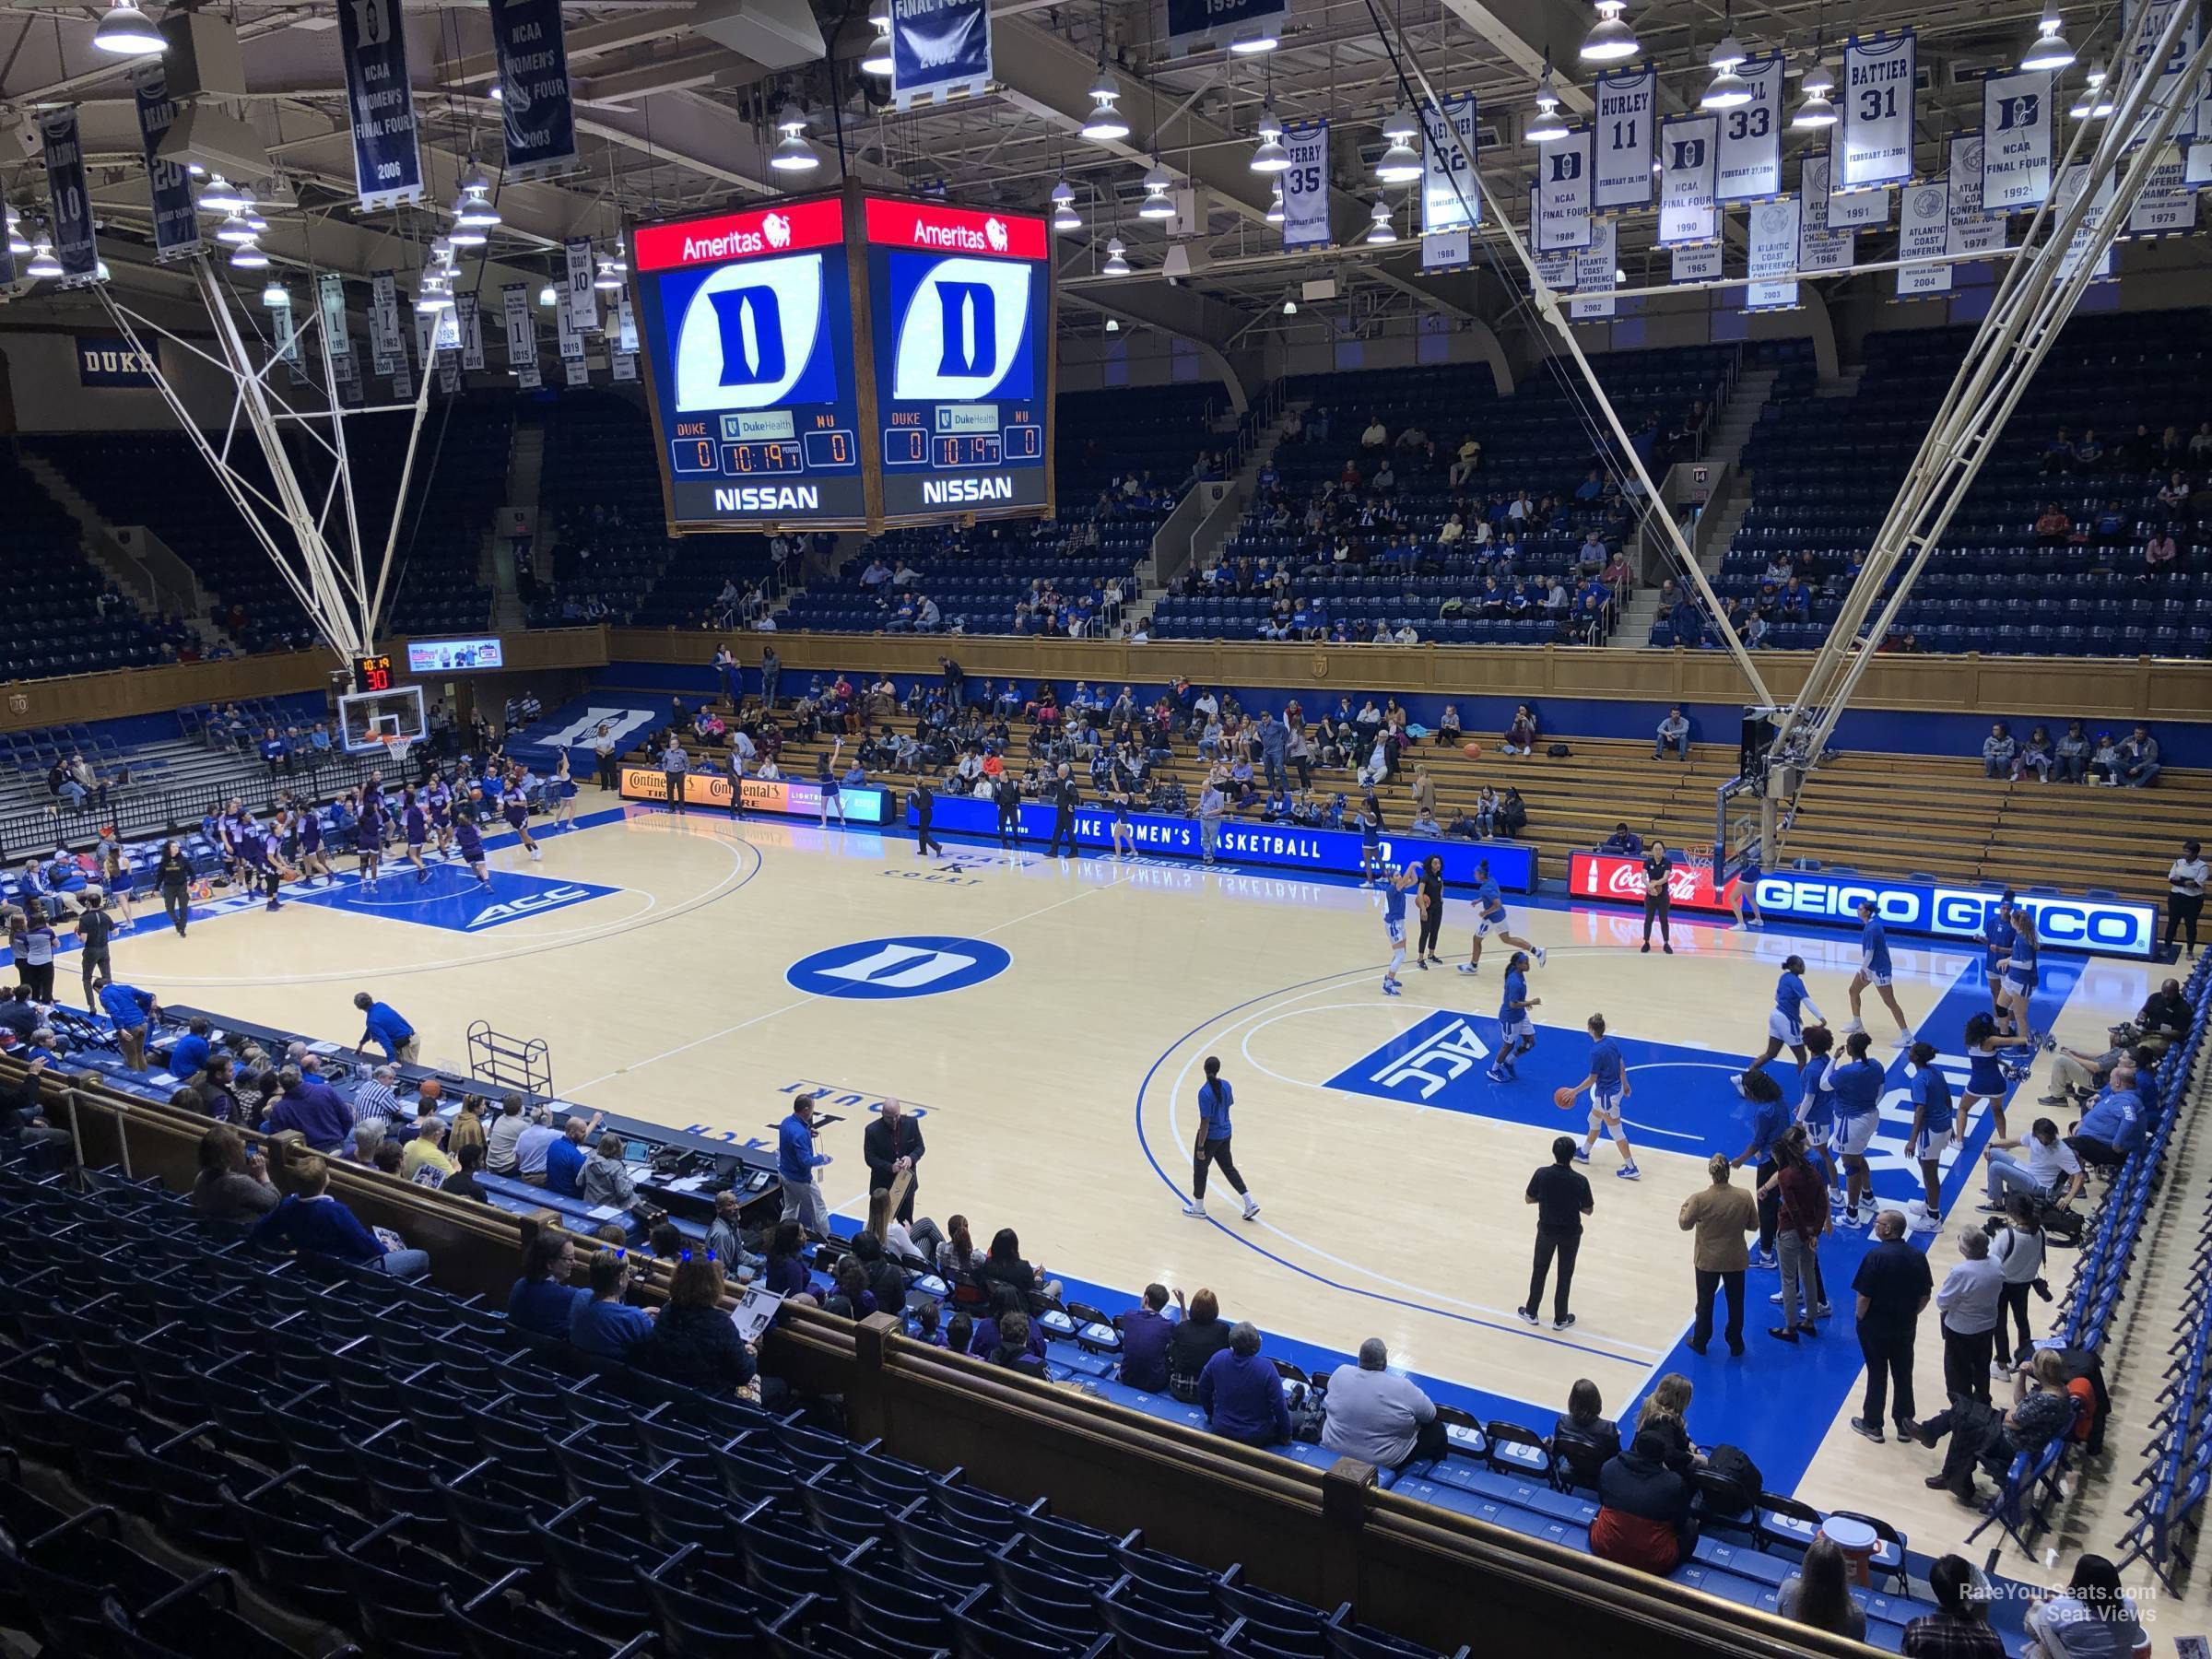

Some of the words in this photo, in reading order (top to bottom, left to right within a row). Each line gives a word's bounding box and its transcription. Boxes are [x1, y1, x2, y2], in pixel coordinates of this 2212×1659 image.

[512, 22, 542, 43] NCAA
[505, 50, 555, 76] WOMEN'S
[365, 63, 390, 82] NCAA
[1852, 59, 1908, 86] BATTIER
[534, 78, 565, 100] FOUR
[357, 88, 403, 111] WOMEN'S
[1602, 93, 1649, 116] HURLEY
[1860, 86, 1898, 121] 31
[356, 120, 384, 139] FINAL
[385, 115, 411, 135] FOUR
[1728, 107, 1771, 140] 33
[524, 130, 551, 149] 2003
[1612, 119, 1637, 149] 11
[1290, 145, 1321, 164] FERRY
[1849, 152, 1881, 162] FEBRUARY
[1883, 147, 1906, 158] 21,2001
[2003, 142, 2030, 154] NCAA
[1434, 145, 1468, 174] 32
[1986, 160, 2016, 174] FINAL
[2019, 157, 2047, 169] FOUR
[378, 162, 401, 180] 2006
[1722, 170, 1750, 179] FEBRUARY
[1290, 167, 1320, 194] 35
[1599, 178, 1627, 187] FEBRUARY
[1675, 182, 1699, 193] NCAA
[1555, 194, 1576, 203] NCAA
[2003, 186, 2029, 198] 1992
[56, 186, 82, 224] 10
[1663, 197, 1685, 208] FINAL
[1688, 195, 1712, 206] FOUR
[1542, 211, 1565, 219] FINAL
[1567, 206, 1589, 217] FOUR
[1846, 207, 1869, 218] 1991
[2150, 213, 2177, 223] 1979
[1677, 222, 1697, 231] 1990
[1909, 226, 1945, 236] ATLANTIC
[914, 219, 984, 250] Ameritas
[1556, 232, 1575, 241] 1989
[1914, 237, 1939, 246] COAST
[682, 230, 762, 261] Ameritas
[1758, 242, 1790, 253] ATLANTIC
[1964, 238, 1988, 249] 1978
[1437, 250, 1455, 259] 1988
[1761, 253, 1784, 262] COAST
[1816, 253, 1838, 264] 1966
[1901, 245, 1945, 258] CONFEREN
[1579, 257, 1607, 266] ATLANTIC
[1687, 265, 1707, 273] 1965
[1751, 260, 1795, 271] CONFERENCE
[573, 271, 588, 291] 10
[1577, 275, 1614, 284] ONFERENCE
[1913, 278, 1936, 288] 2004
[1764, 291, 1781, 300] 2003
[1583, 304, 1602, 312] 2002
[817, 415, 834, 428] NU
[891, 412, 921, 425] DUKE
[955, 413, 996, 425] DukeHealth
[1015, 411, 1029, 423] NU
[677, 423, 707, 436] DUKE
[743, 419, 792, 432] DukeHealth
[831, 434, 846, 463] 0
[911, 432, 921, 459] 0
[1025, 429, 1034, 454] 0
[698, 441, 711, 467] 0
[734, 444, 783, 472] 10:19
[944, 438, 985, 465] 10:19
[924, 477, 1012, 504] NISSAN
[714, 486, 818, 511] NISSAN
[363, 657, 389, 671] 10:19
[367, 670, 388, 691] 30
[646, 790, 667, 799] TIR
[1201, 831, 1321, 859] ASKETBALL
[884, 869, 983, 886] COURT
[468, 885, 589, 924] ACC
[1755, 878, 1920, 923] GEICO
[1382, 1025, 1490, 1100] ACC
